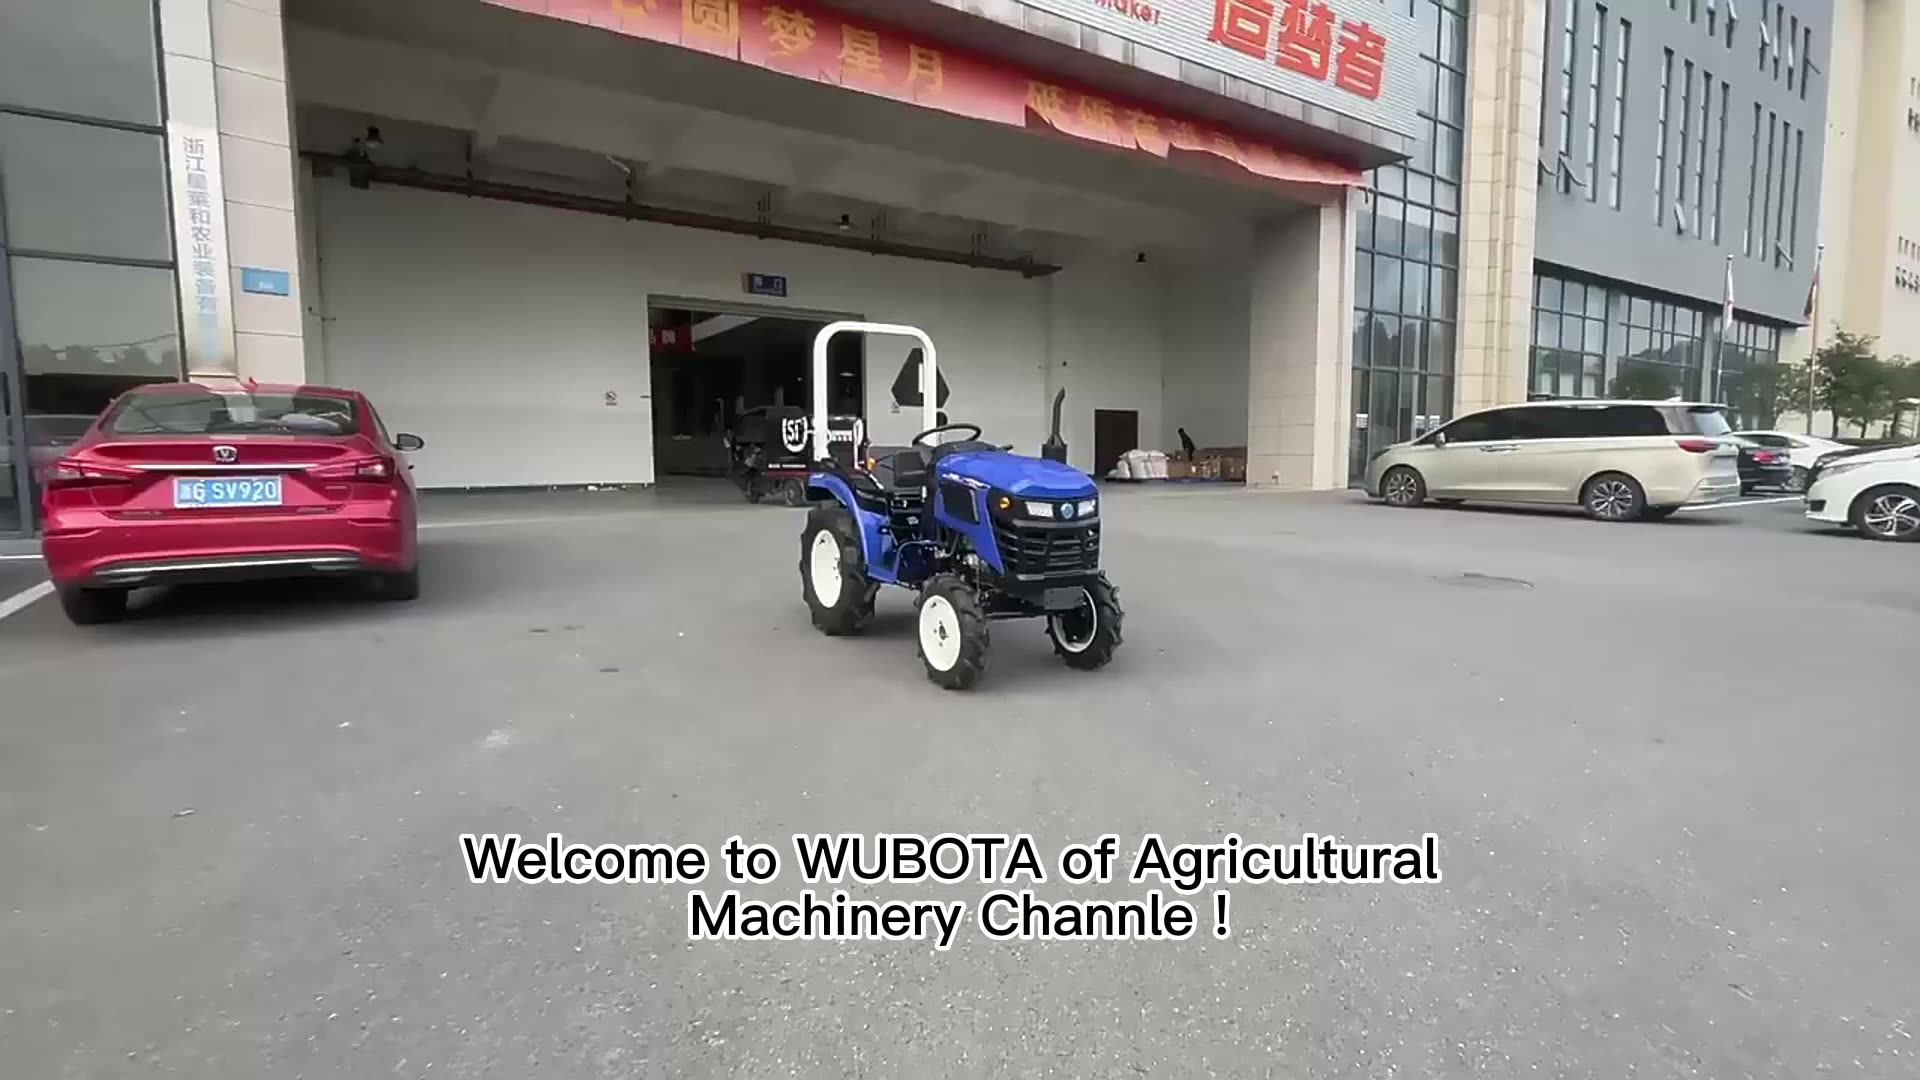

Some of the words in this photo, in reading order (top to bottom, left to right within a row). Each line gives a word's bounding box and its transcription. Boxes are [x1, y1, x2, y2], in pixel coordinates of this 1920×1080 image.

[1208, 0, 1387, 100] 造梦者
[212, 481, 278, 501] SV920
